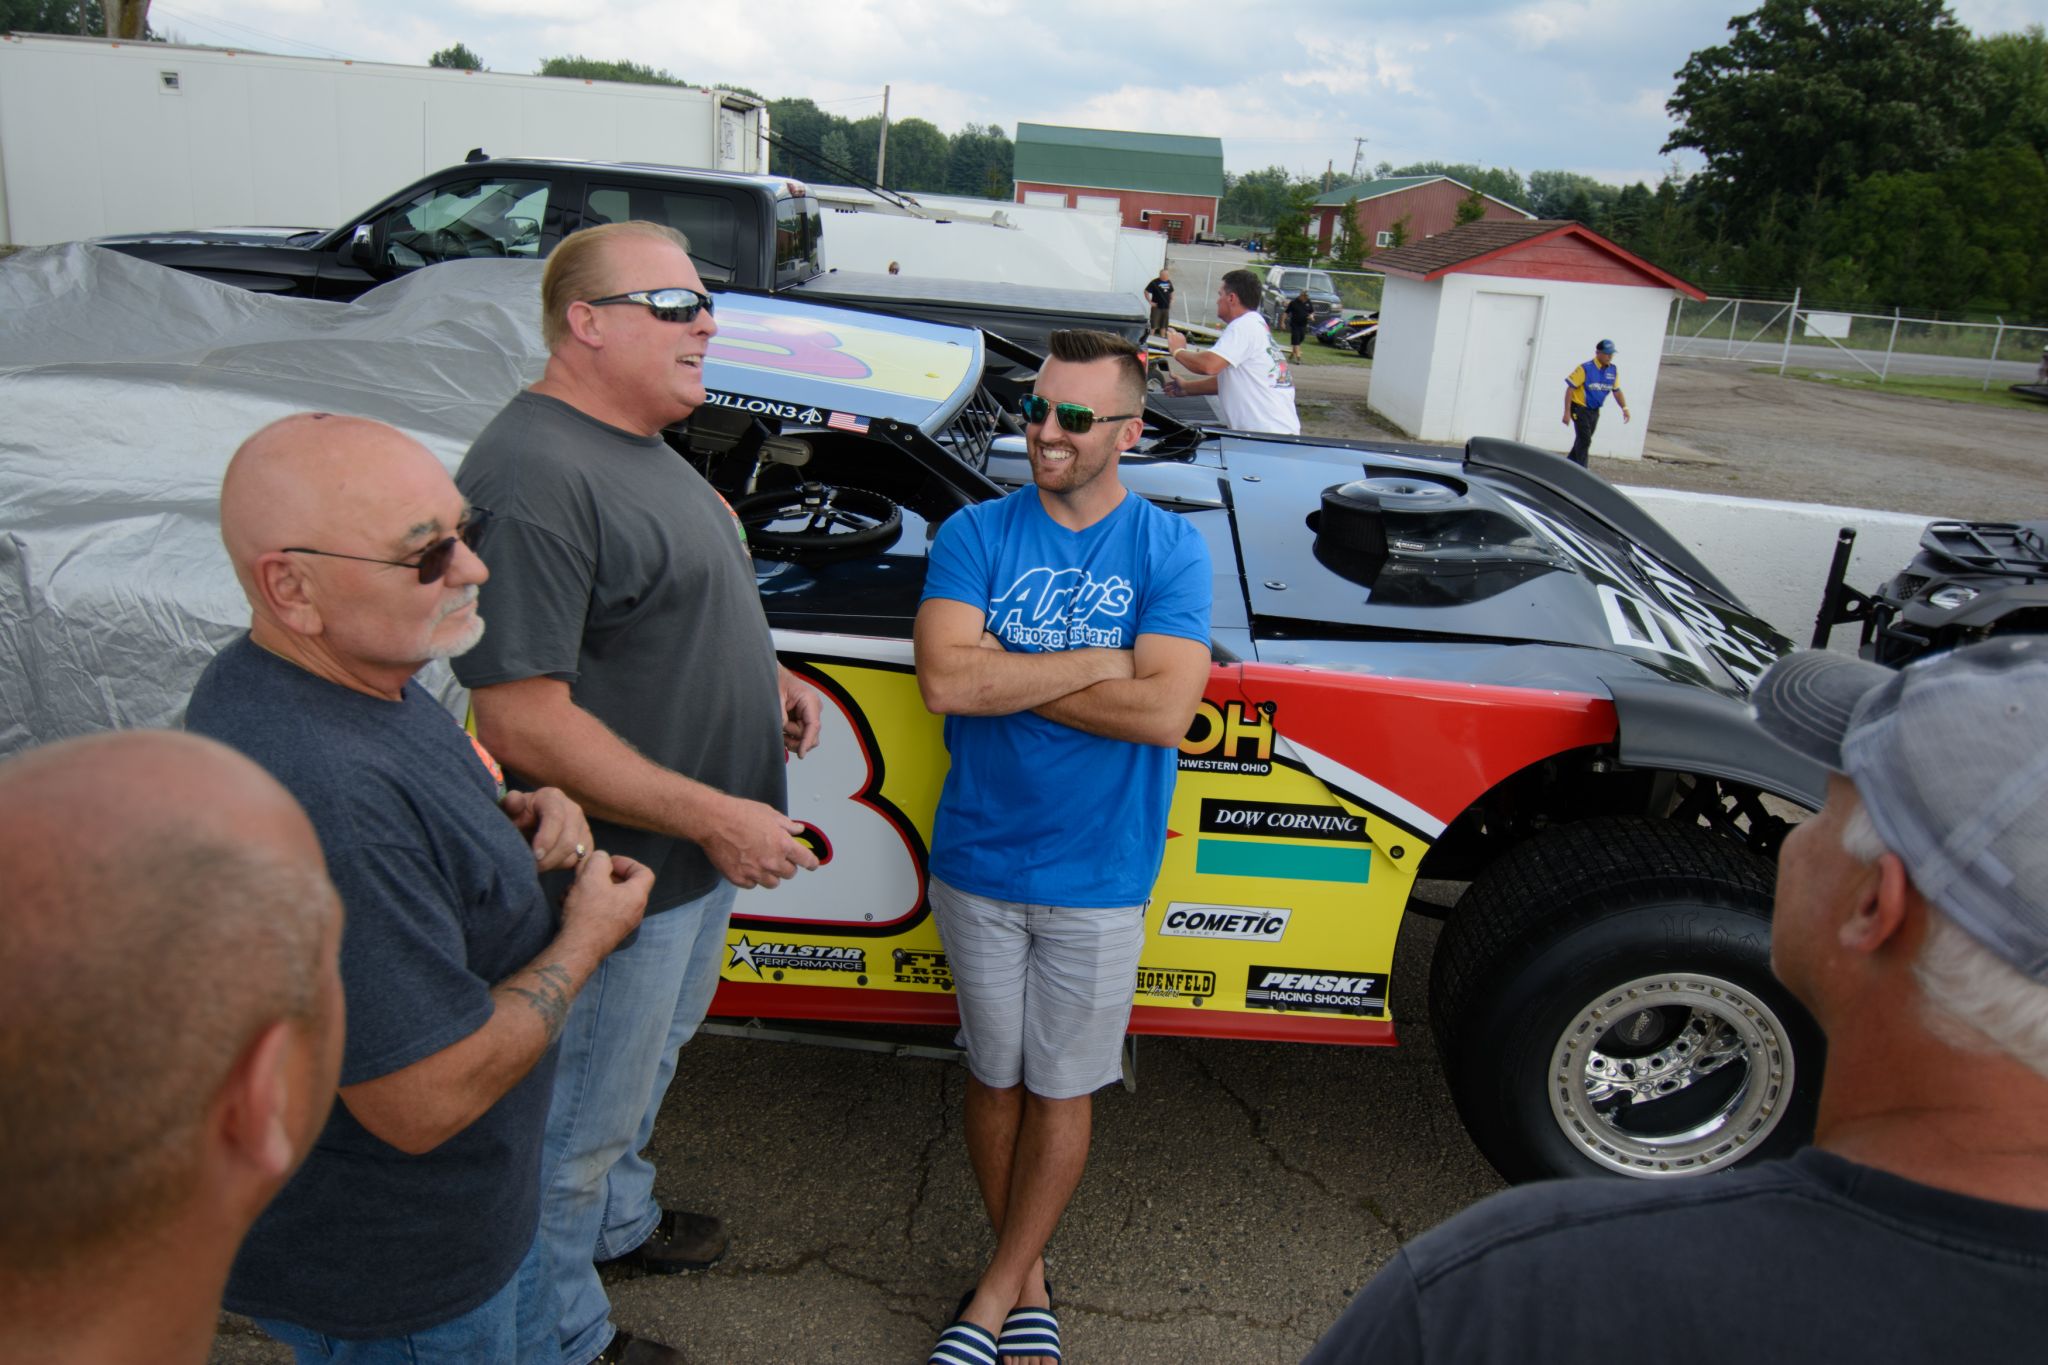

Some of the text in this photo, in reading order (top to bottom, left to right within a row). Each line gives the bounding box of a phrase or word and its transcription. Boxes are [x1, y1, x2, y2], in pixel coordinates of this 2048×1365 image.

[1240, 762, 1269, 774] OHIO
[1215, 808, 1360, 833] DOW CORNING
[1166, 910, 1284, 935] COMETIC
[753, 942, 863, 960] ALLSTAR
[755, 957, 863, 971] PERFORMANCE
[1260, 972, 1375, 994] PENSKE
[1270, 991, 1361, 1006] RACING SHOCKS
